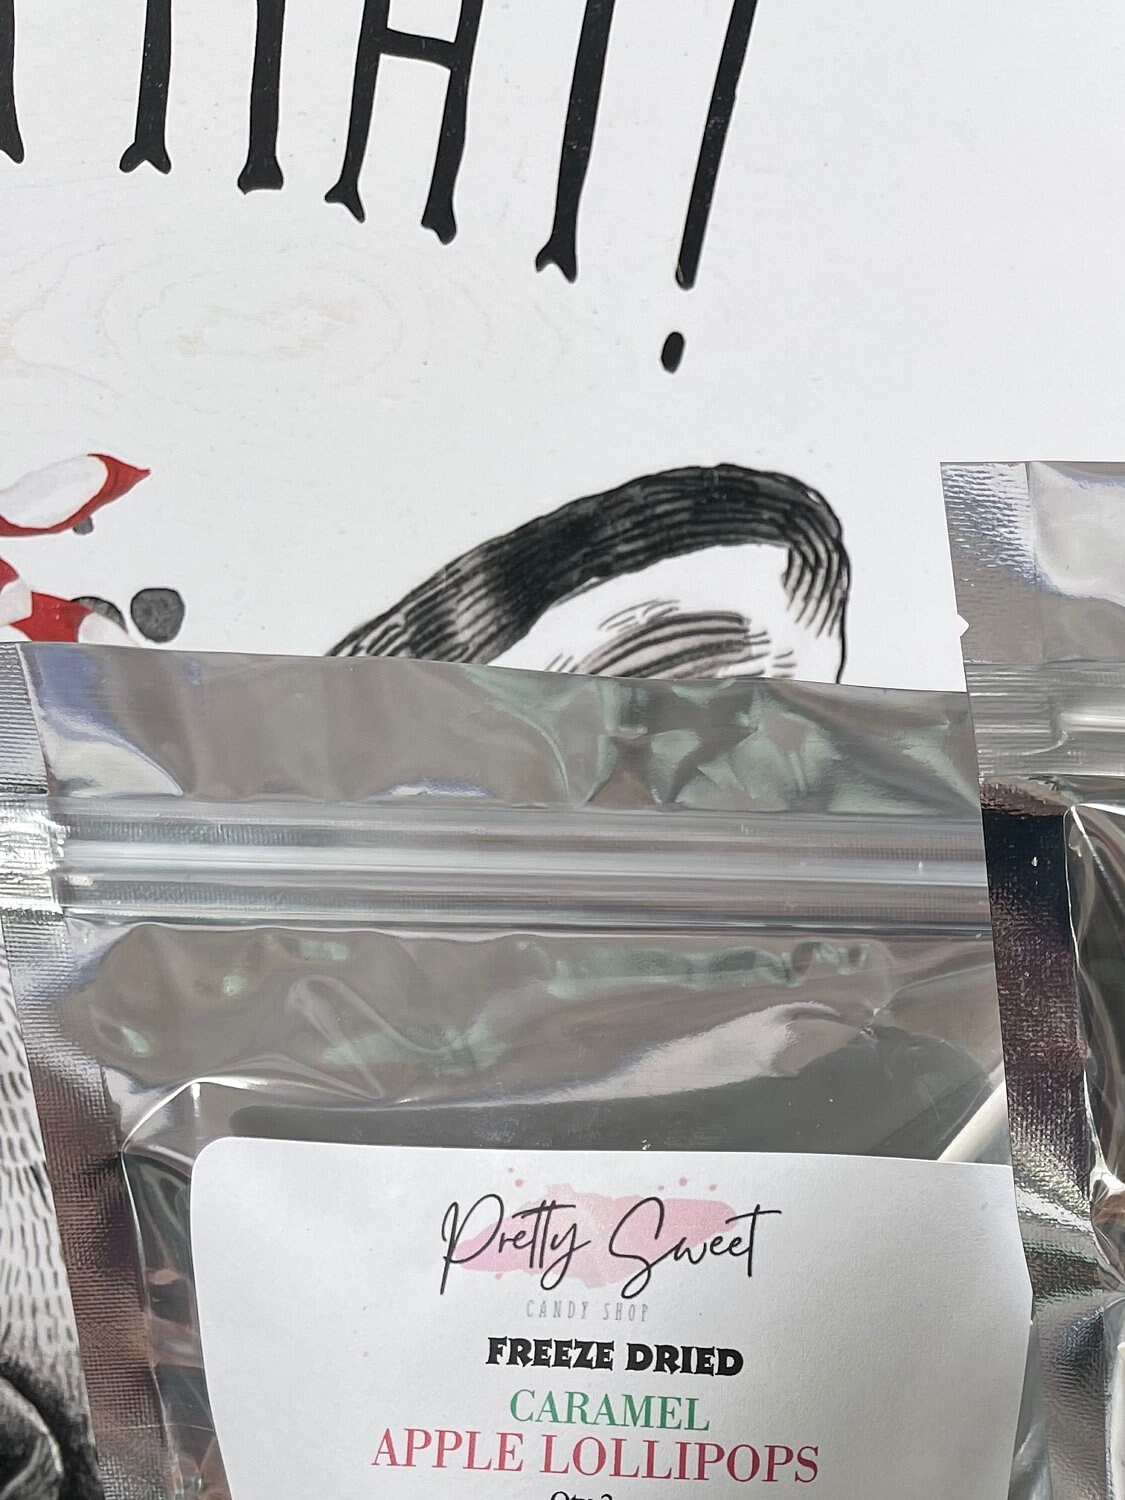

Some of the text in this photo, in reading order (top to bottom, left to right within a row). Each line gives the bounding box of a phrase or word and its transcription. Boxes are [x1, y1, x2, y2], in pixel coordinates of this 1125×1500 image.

[439, 1193, 783, 1300] Pretty Sweet
[526, 1299, 649, 1323] CANDY SHOP
[485, 1335, 744, 1377] FREEZE DRIED
[509, 1388, 710, 1431] CARAMEL
[371, 1427, 819, 1484] APPLE LOLLIPOPS
